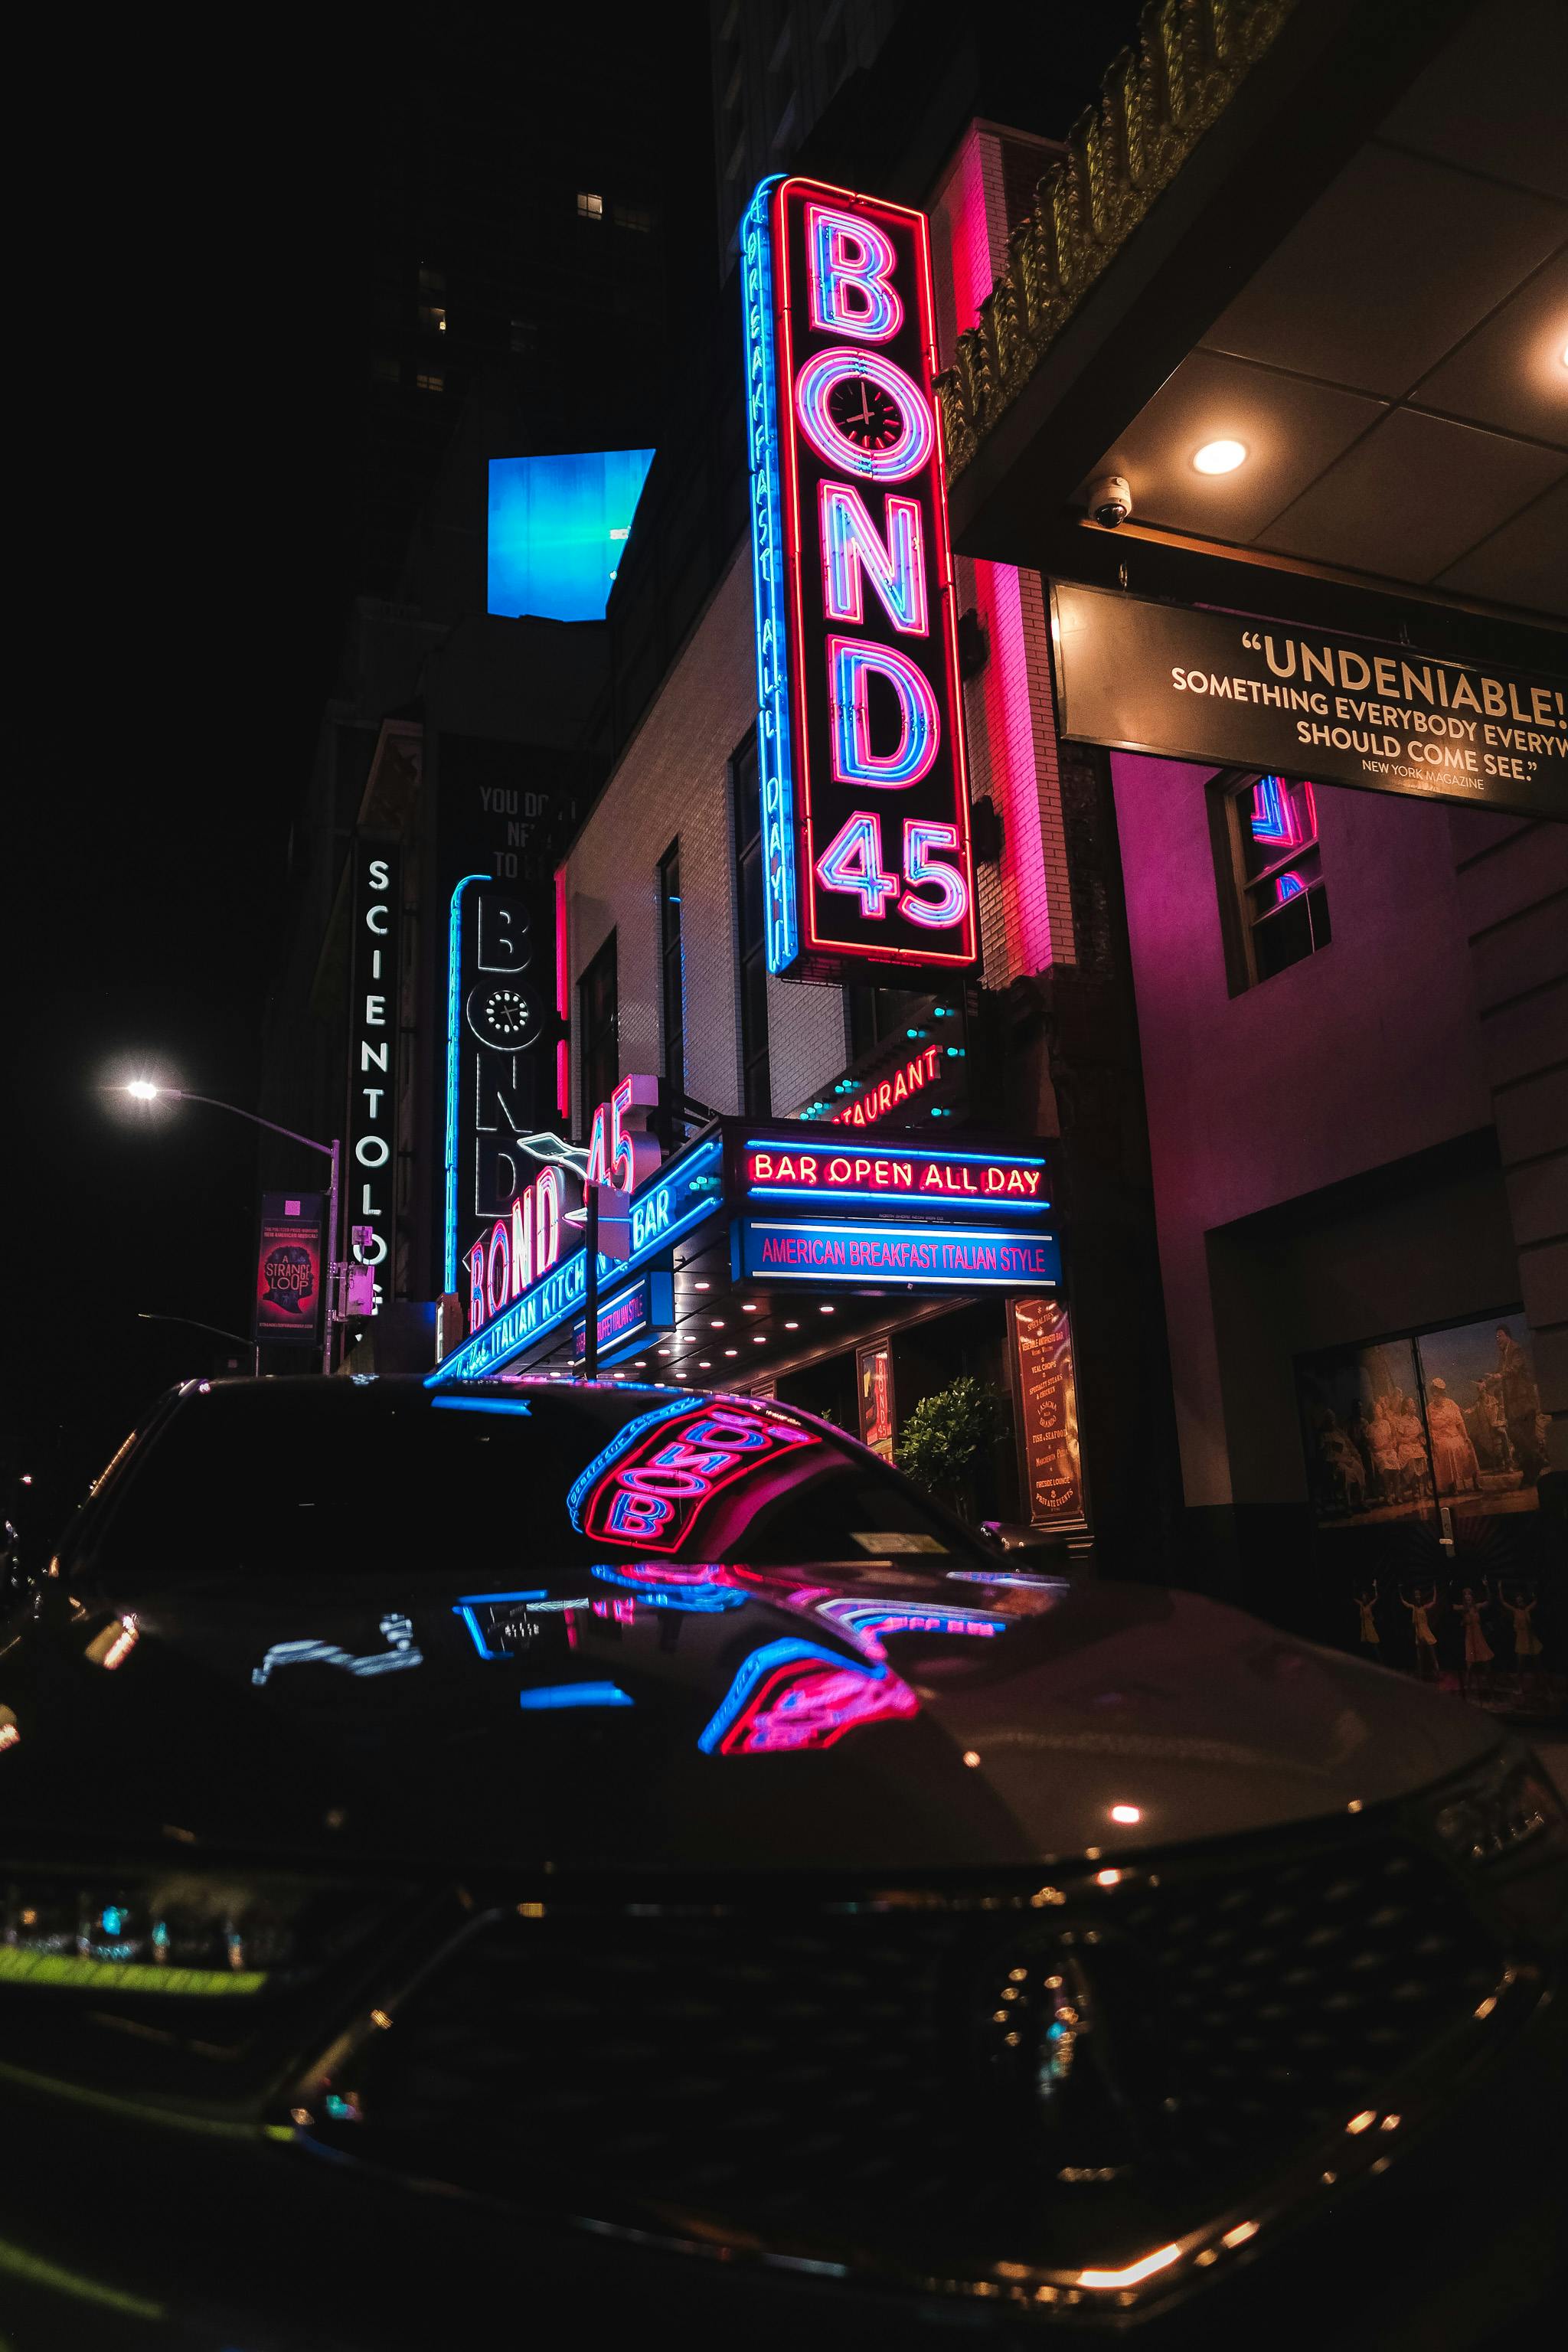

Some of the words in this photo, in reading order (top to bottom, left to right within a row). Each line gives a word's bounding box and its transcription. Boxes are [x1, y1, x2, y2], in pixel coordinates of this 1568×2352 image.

[795, 201, 941, 789] BOND
[1171, 667, 1328, 714] SOMETHING
[1337, 699, 1477, 742] EVERYBODY
[1297, 720, 1400, 758] SHOULD
[1407, 740, 1478, 773] COME
[1362, 760, 1388, 774] NEW
[1390, 763, 1423, 780] YORK
[1426, 770, 1485, 790] MAGAZINE
[479, 786, 518, 815] YOU
[493, 851, 518, 878] TO
[814, 810, 969, 929] 45
[354, 860, 390, 1342] SCIENTOLO
[832, 1044, 939, 1127] TAURANT
[753, 1154, 817, 1183] BAR
[828, 1158, 913, 1187] OPEN
[921, 1163, 978, 1192] ALL
[985, 1167, 1041, 1195] DAY
[282, 1255, 289, 1263] A
[469, 1165, 560, 1335] BOND
[762, 1238, 844, 1266] AMERICAN
[850, 1240, 939, 1269] BREAKFAST
[942, 1244, 997, 1271] ITALIAN
[1000, 1246, 1047, 1272] STYLE
[266, 1263, 311, 1281] STRANGE
[270, 1273, 309, 1296] LOOP
[491, 1297, 537, 1357] ITALIAN
[541, 1252, 607, 1321] KITCHN
[633, 1189, 670, 1252] BAR
[877, 1425, 887, 1437] 45
[1032, 1433, 1043, 1443] FISH
